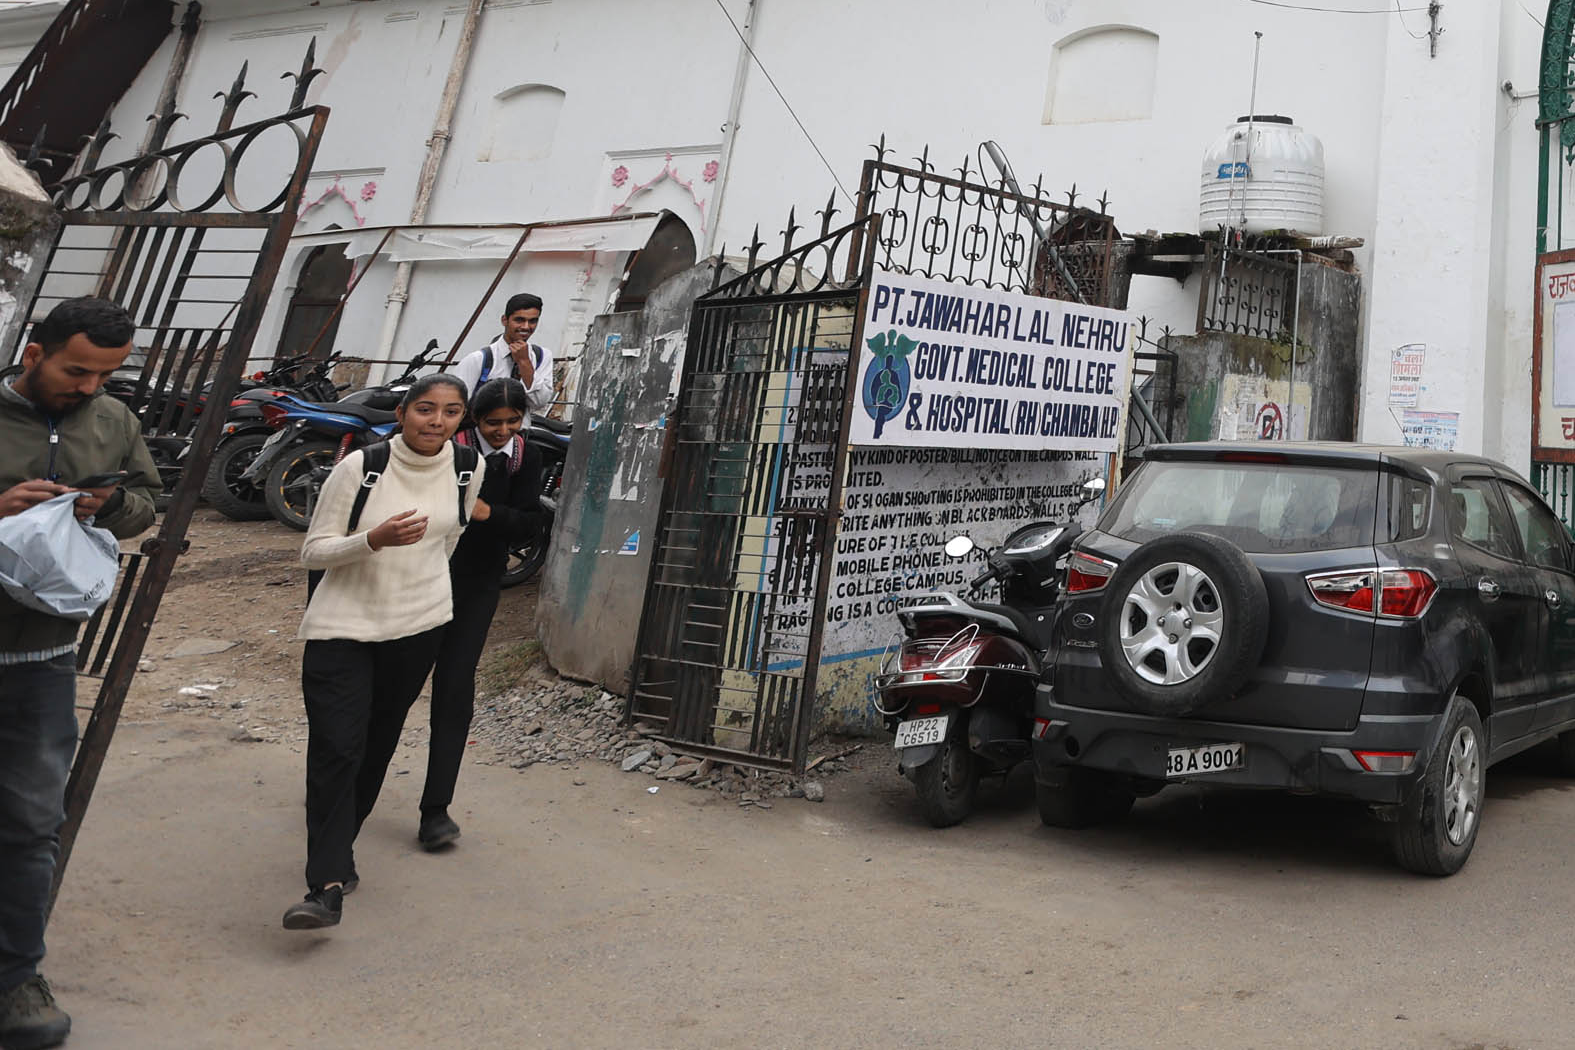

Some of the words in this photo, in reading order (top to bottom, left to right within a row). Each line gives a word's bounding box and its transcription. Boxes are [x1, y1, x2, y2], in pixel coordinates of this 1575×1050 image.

[1013, 306, 1054, 346] LAL
[1060, 312, 1128, 353] NEHRU
[1041, 356, 1117, 396] COLLEGE
[905, 391, 923, 431] &
[867, 449, 895, 465] KIND
[895, 449, 909, 464] OF
[1074, 450, 1099, 461] WALL
[846, 493, 861, 510] OF
[904, 489, 953, 507] SHOUTING
[953, 488, 962, 504] IS
[962, 486, 1014, 503] PROHIBITED
[1014, 486, 1026, 500] IN
[1025, 485, 1042, 500] THE
[1041, 484, 1073, 499] COLLEGE
[870, 510, 933, 530] ANYTHING
[868, 536, 887, 552] OF
[836, 555, 890, 577] MOBILE
[892, 550, 942, 571] PHONE
[836, 577, 901, 599] COLLEGE
[905, 569, 967, 591] CAMPUS.
[847, 602, 863, 620] IS
[863, 601, 873, 618] A
[909, 718, 938, 733] HP22
[903, 731, 940, 746] C6519
[1186, 751, 1199, 771] A
[1202, 748, 1243, 770] 9001
